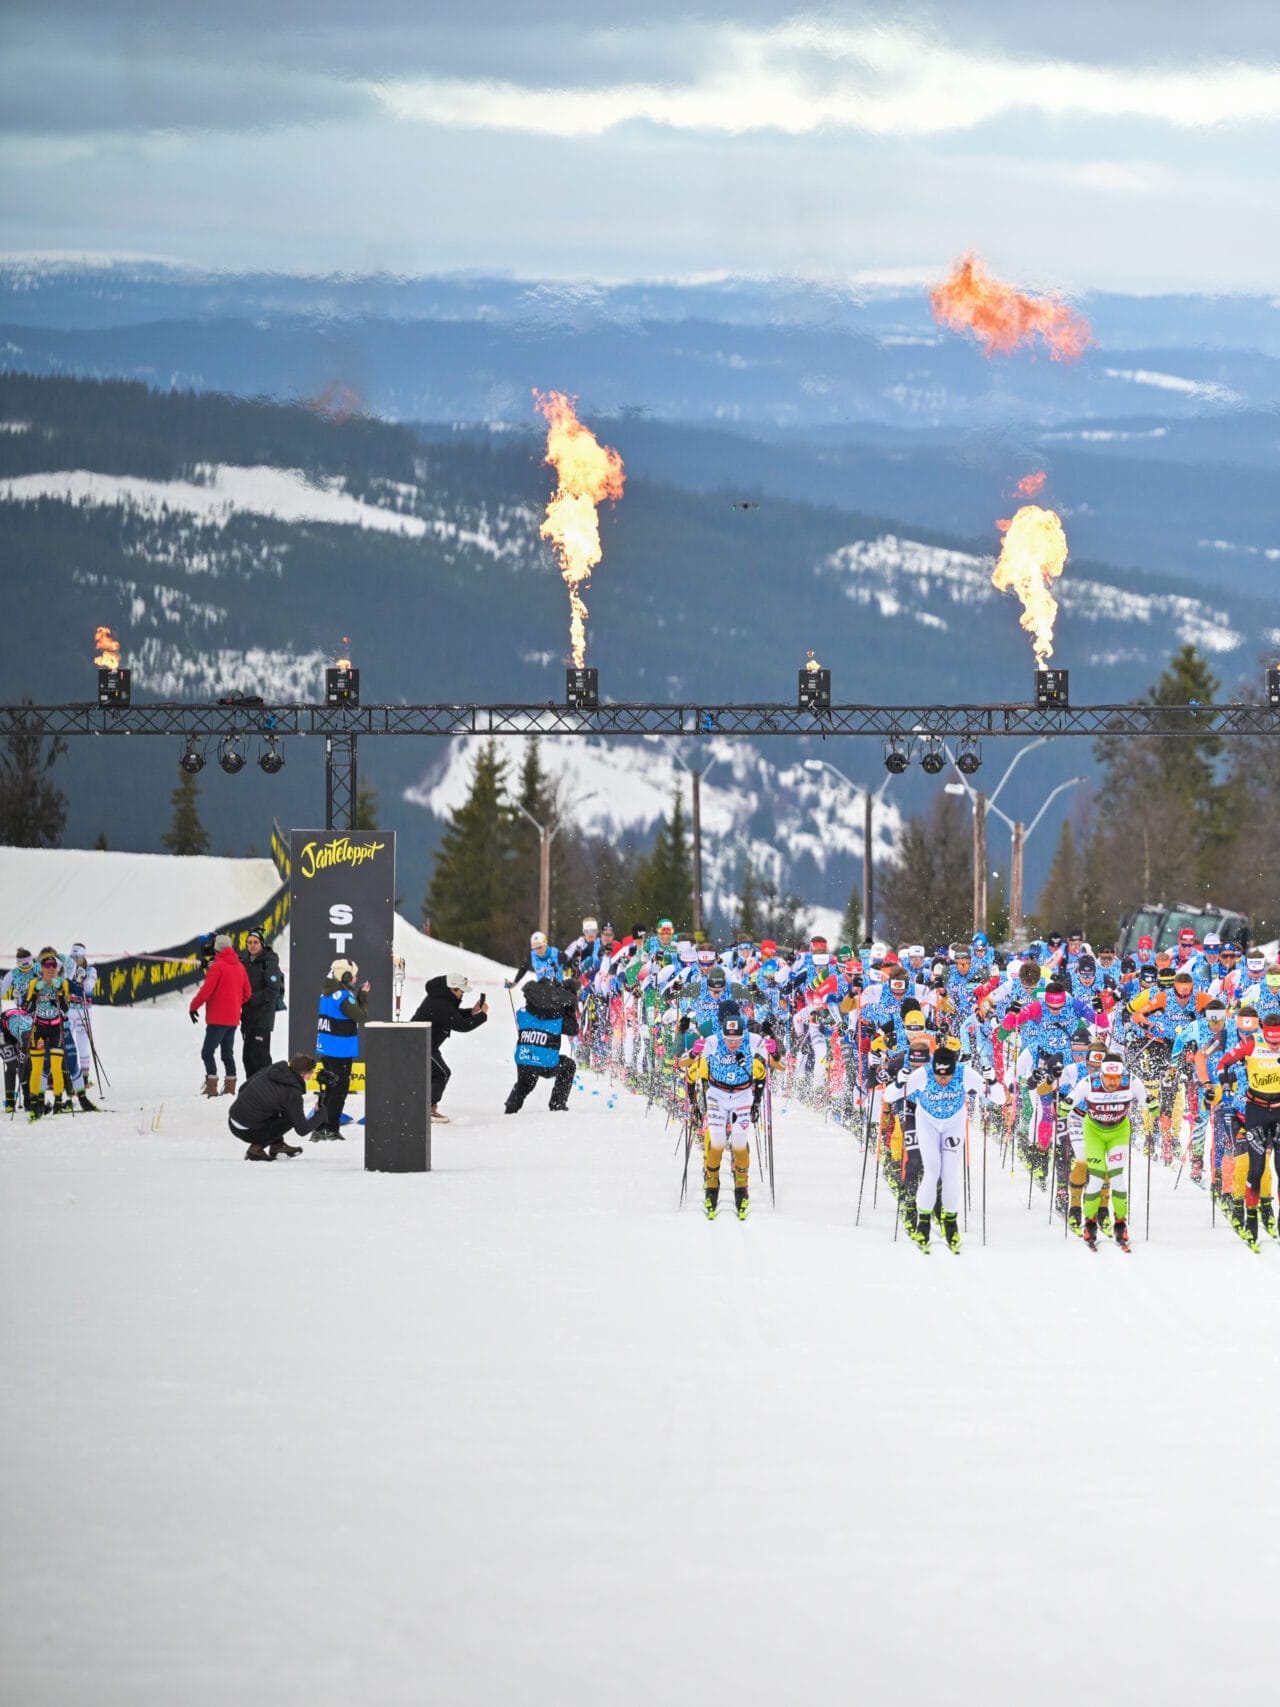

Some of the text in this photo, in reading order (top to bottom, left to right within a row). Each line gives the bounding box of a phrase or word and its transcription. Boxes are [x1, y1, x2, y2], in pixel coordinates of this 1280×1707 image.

[301, 837, 385, 878] Janteloppet
[520, 1030, 548, 1046] PHOTO
[1048, 1037, 1067, 1047] 23
[1096, 1104, 1125, 1112] CLIMB
